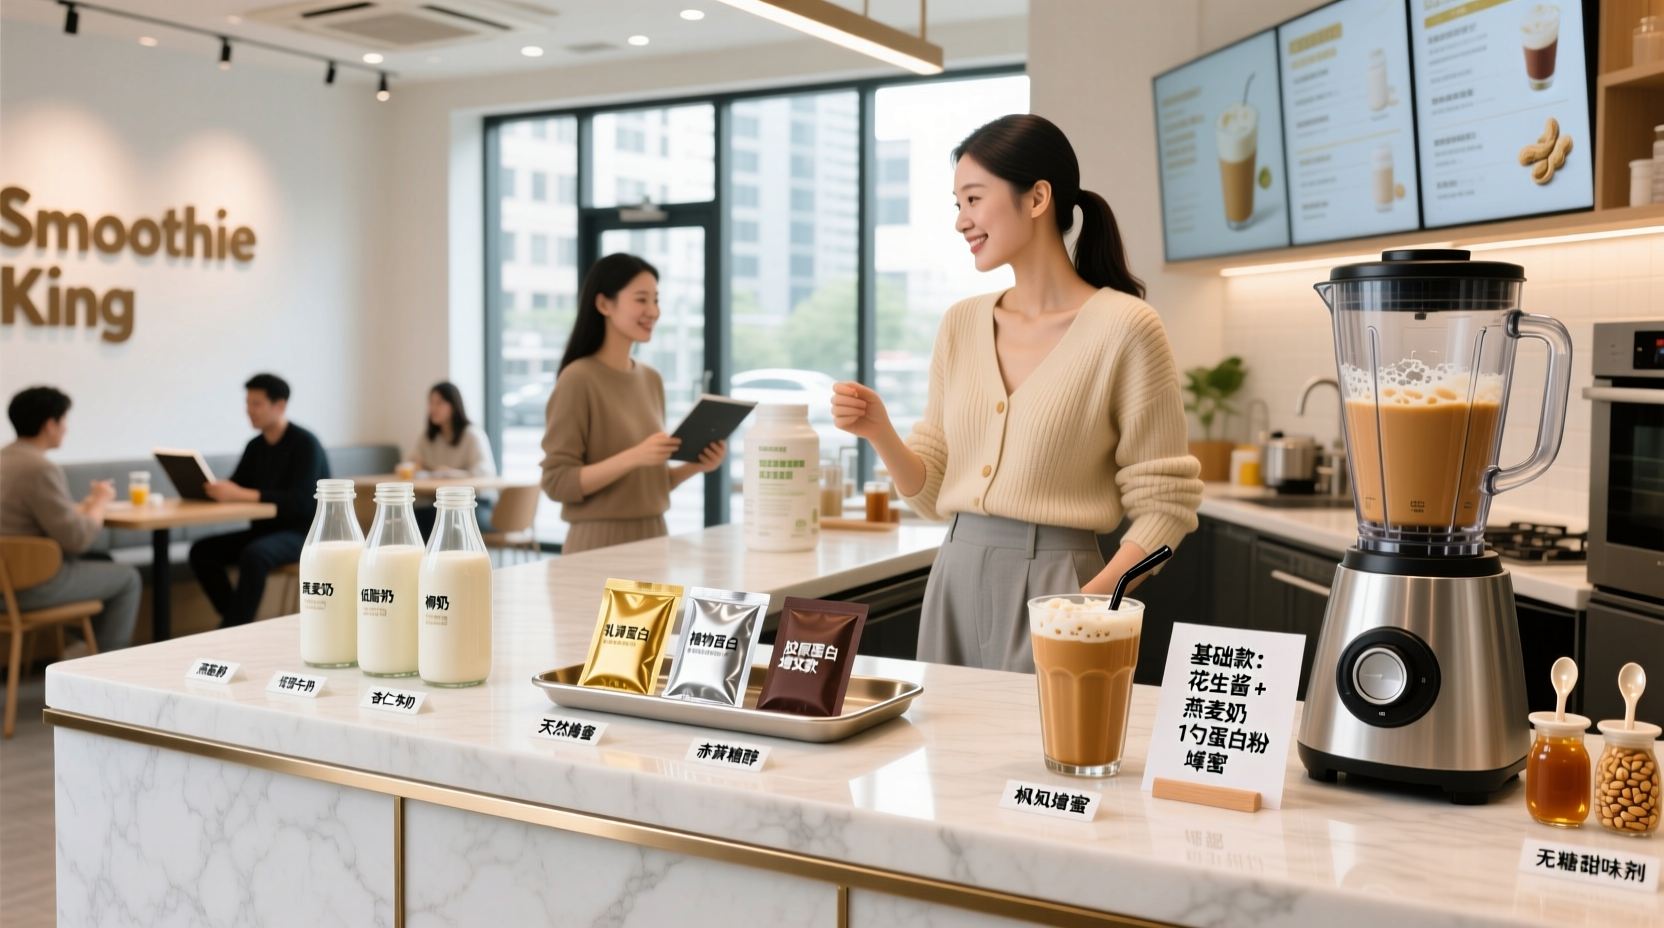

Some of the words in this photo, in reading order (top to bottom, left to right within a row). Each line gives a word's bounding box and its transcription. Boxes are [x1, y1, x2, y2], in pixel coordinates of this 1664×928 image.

[0, 187, 256, 262] Smoothie
[1, 266, 135, 343] King
[1182, 696, 1248, 725] 燕麦奶
[1179, 723, 1270, 754] 1勺蛋白粉
[1536, 848, 1646, 883] 无糖甜味剂
